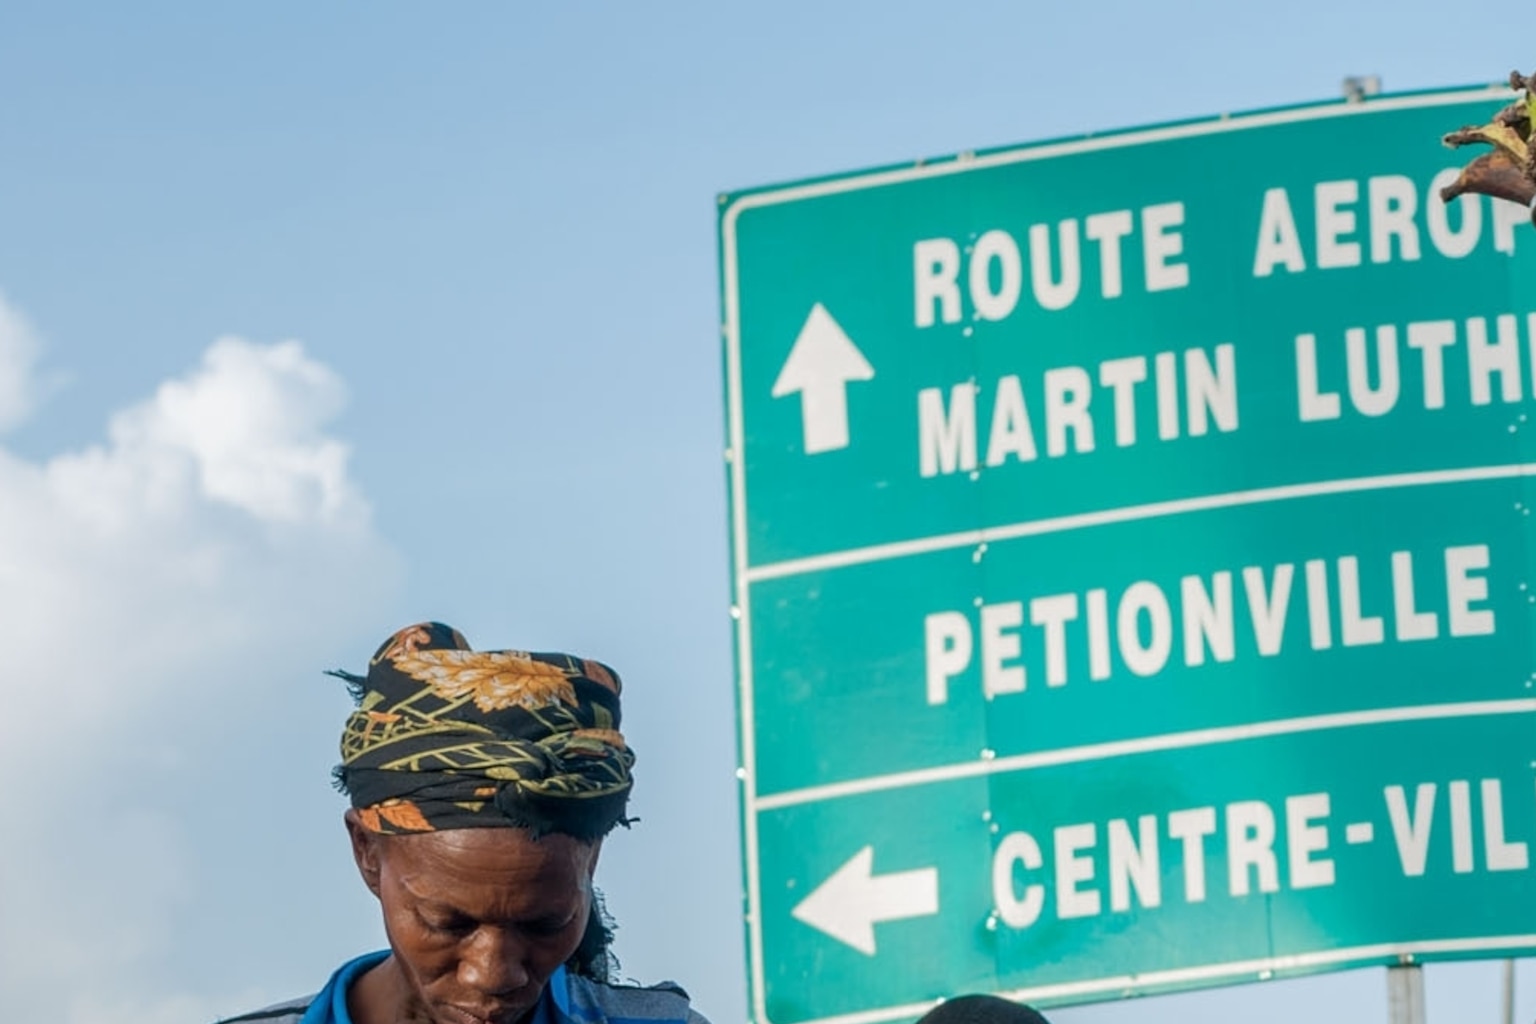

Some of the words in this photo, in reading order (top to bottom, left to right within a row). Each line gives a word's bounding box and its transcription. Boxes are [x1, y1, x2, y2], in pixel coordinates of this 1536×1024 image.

[915, 203, 1188, 327] ROUTE
[919, 344, 1238, 477] MARTIN
[925, 545, 1495, 705] PETIONVILLE
